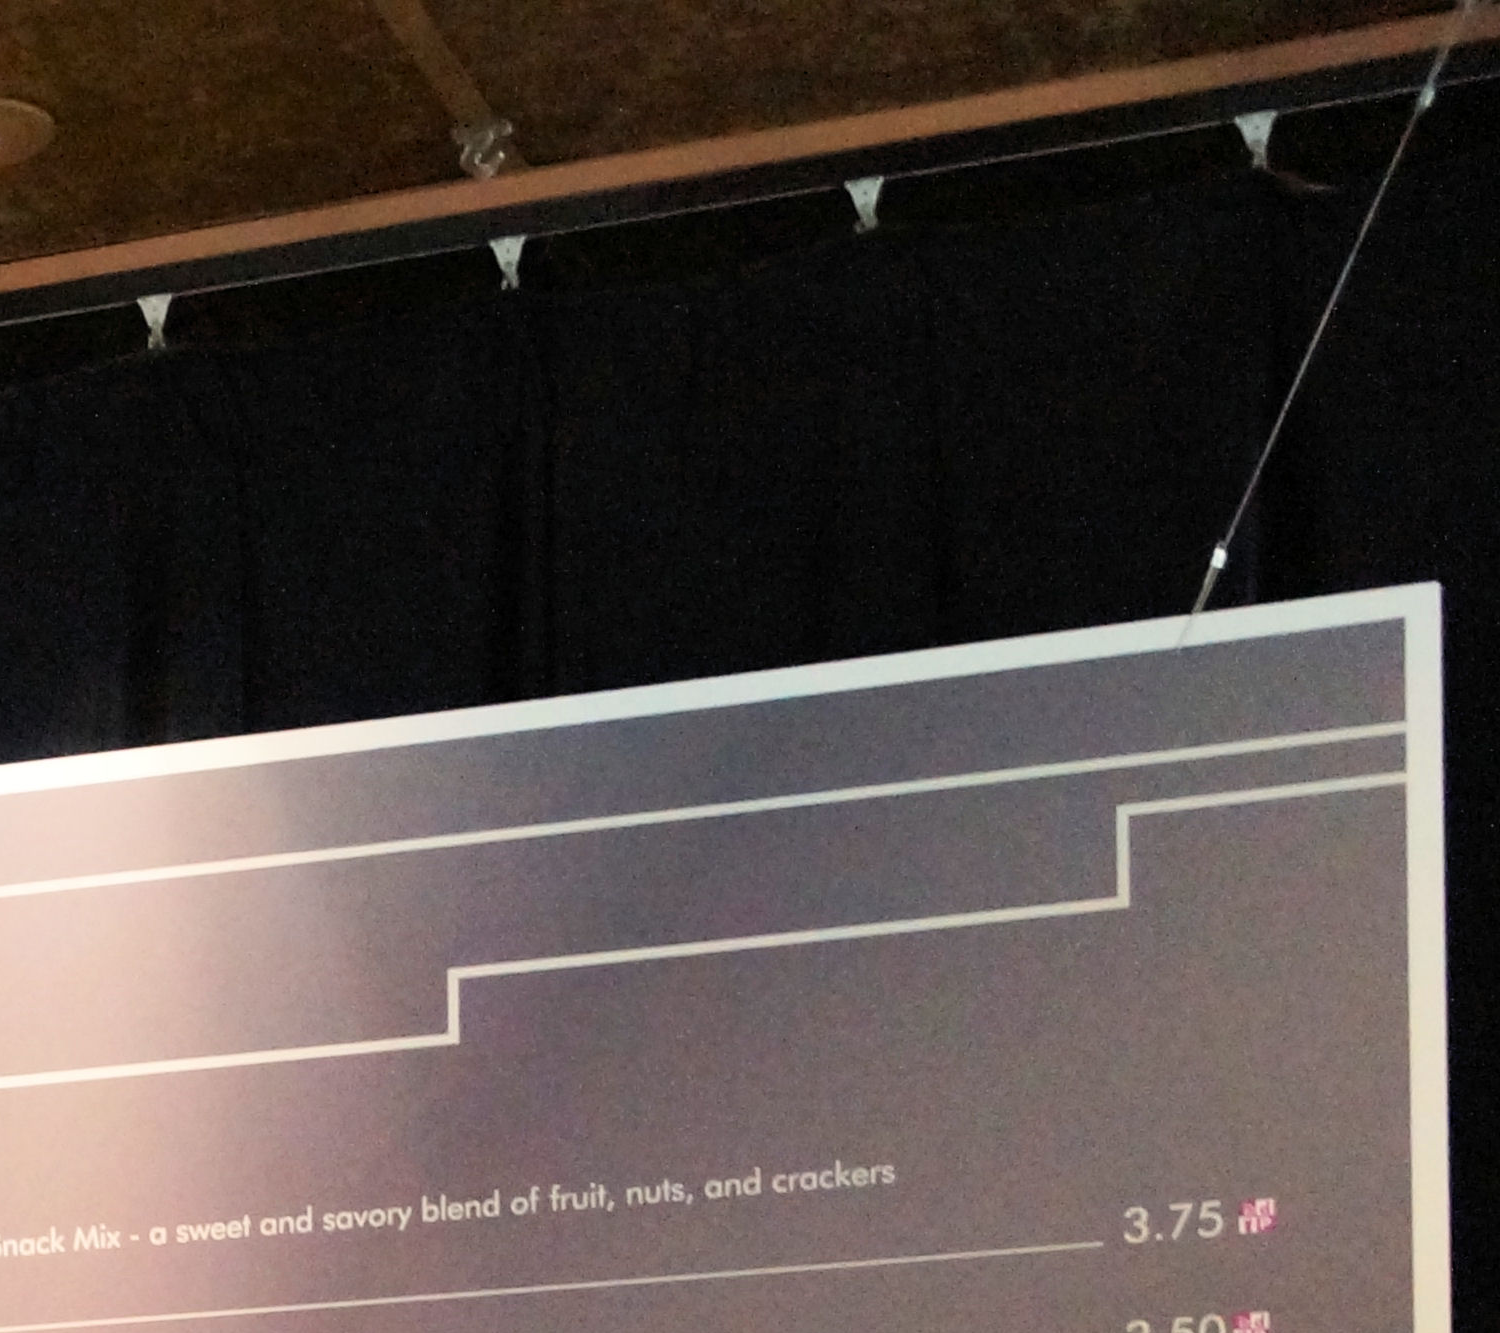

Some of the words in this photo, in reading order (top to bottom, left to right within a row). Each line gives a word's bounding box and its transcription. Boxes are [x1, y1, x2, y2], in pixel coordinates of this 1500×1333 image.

[73, 1227, 120, 1250] Mix
[149, 1226, 167, 1246] a
[176, 1214, 252, 1244] sweet
[259, 1204, 314, 1237] and
[321, 1205, 414, 1233] savory
[420, 1188, 501, 1224] blend
[509, 1184, 540, 1217] of
[548, 1181, 616, 1213] fruit,
[625, 1178, 694, 1206] nuts,
[703, 1165, 762, 1200] and
[770, 1158, 897, 1195] crackers
[1123, 1199, 1224, 1245] 3.75
